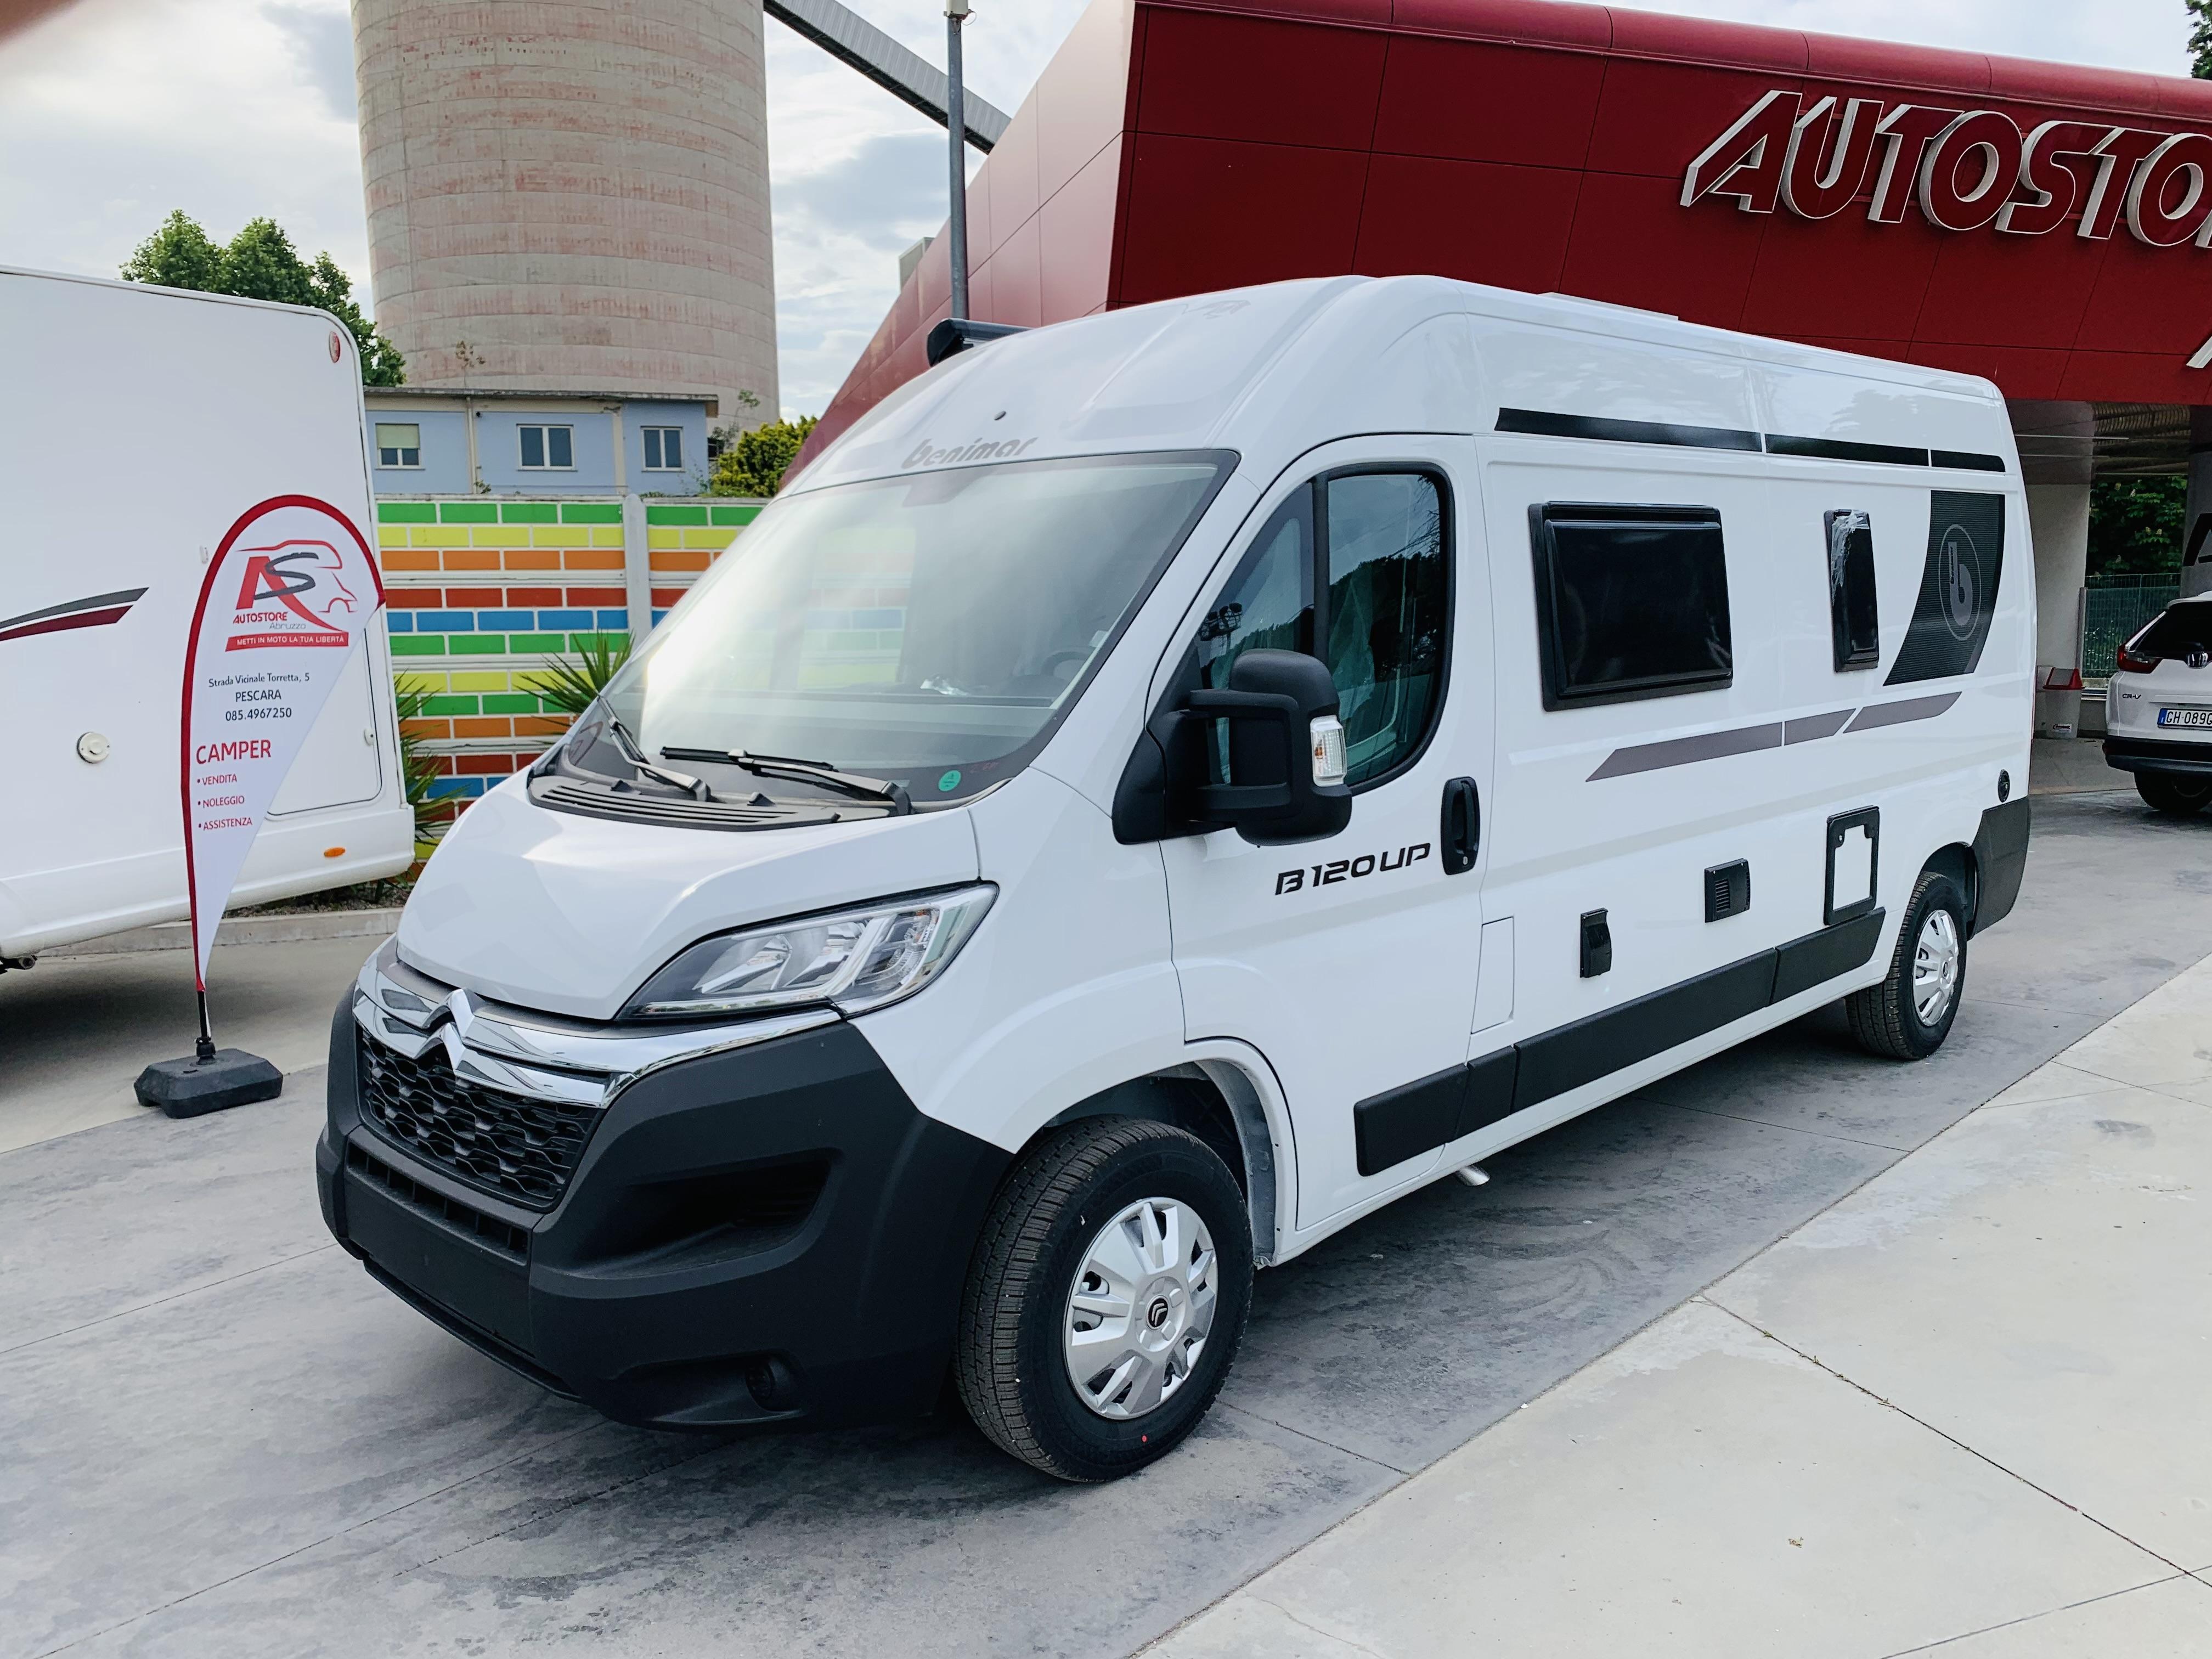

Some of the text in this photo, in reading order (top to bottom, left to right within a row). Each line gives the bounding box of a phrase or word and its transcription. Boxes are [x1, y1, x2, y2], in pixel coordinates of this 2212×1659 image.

[1680, 89, 2212, 248] AUTOSTO
[901, 437, 1039, 470] benimar
[233, 611, 288, 624] AUTOSTORE
[208, 672, 310, 687] Strada Vicinale Torretta, 5
[235, 689, 281, 702] PESCARA
[225, 707, 292, 721] 085.4967250
[2166, 711, 2181, 724] GH
[196, 740, 271, 764] CAMPER
[202, 774, 237, 786] VENDITA
[202, 795, 245, 808] NOLEGGIO
[203, 817, 253, 831] ASSISTENZA
[1274, 842, 1431, 895] B 120 UP
